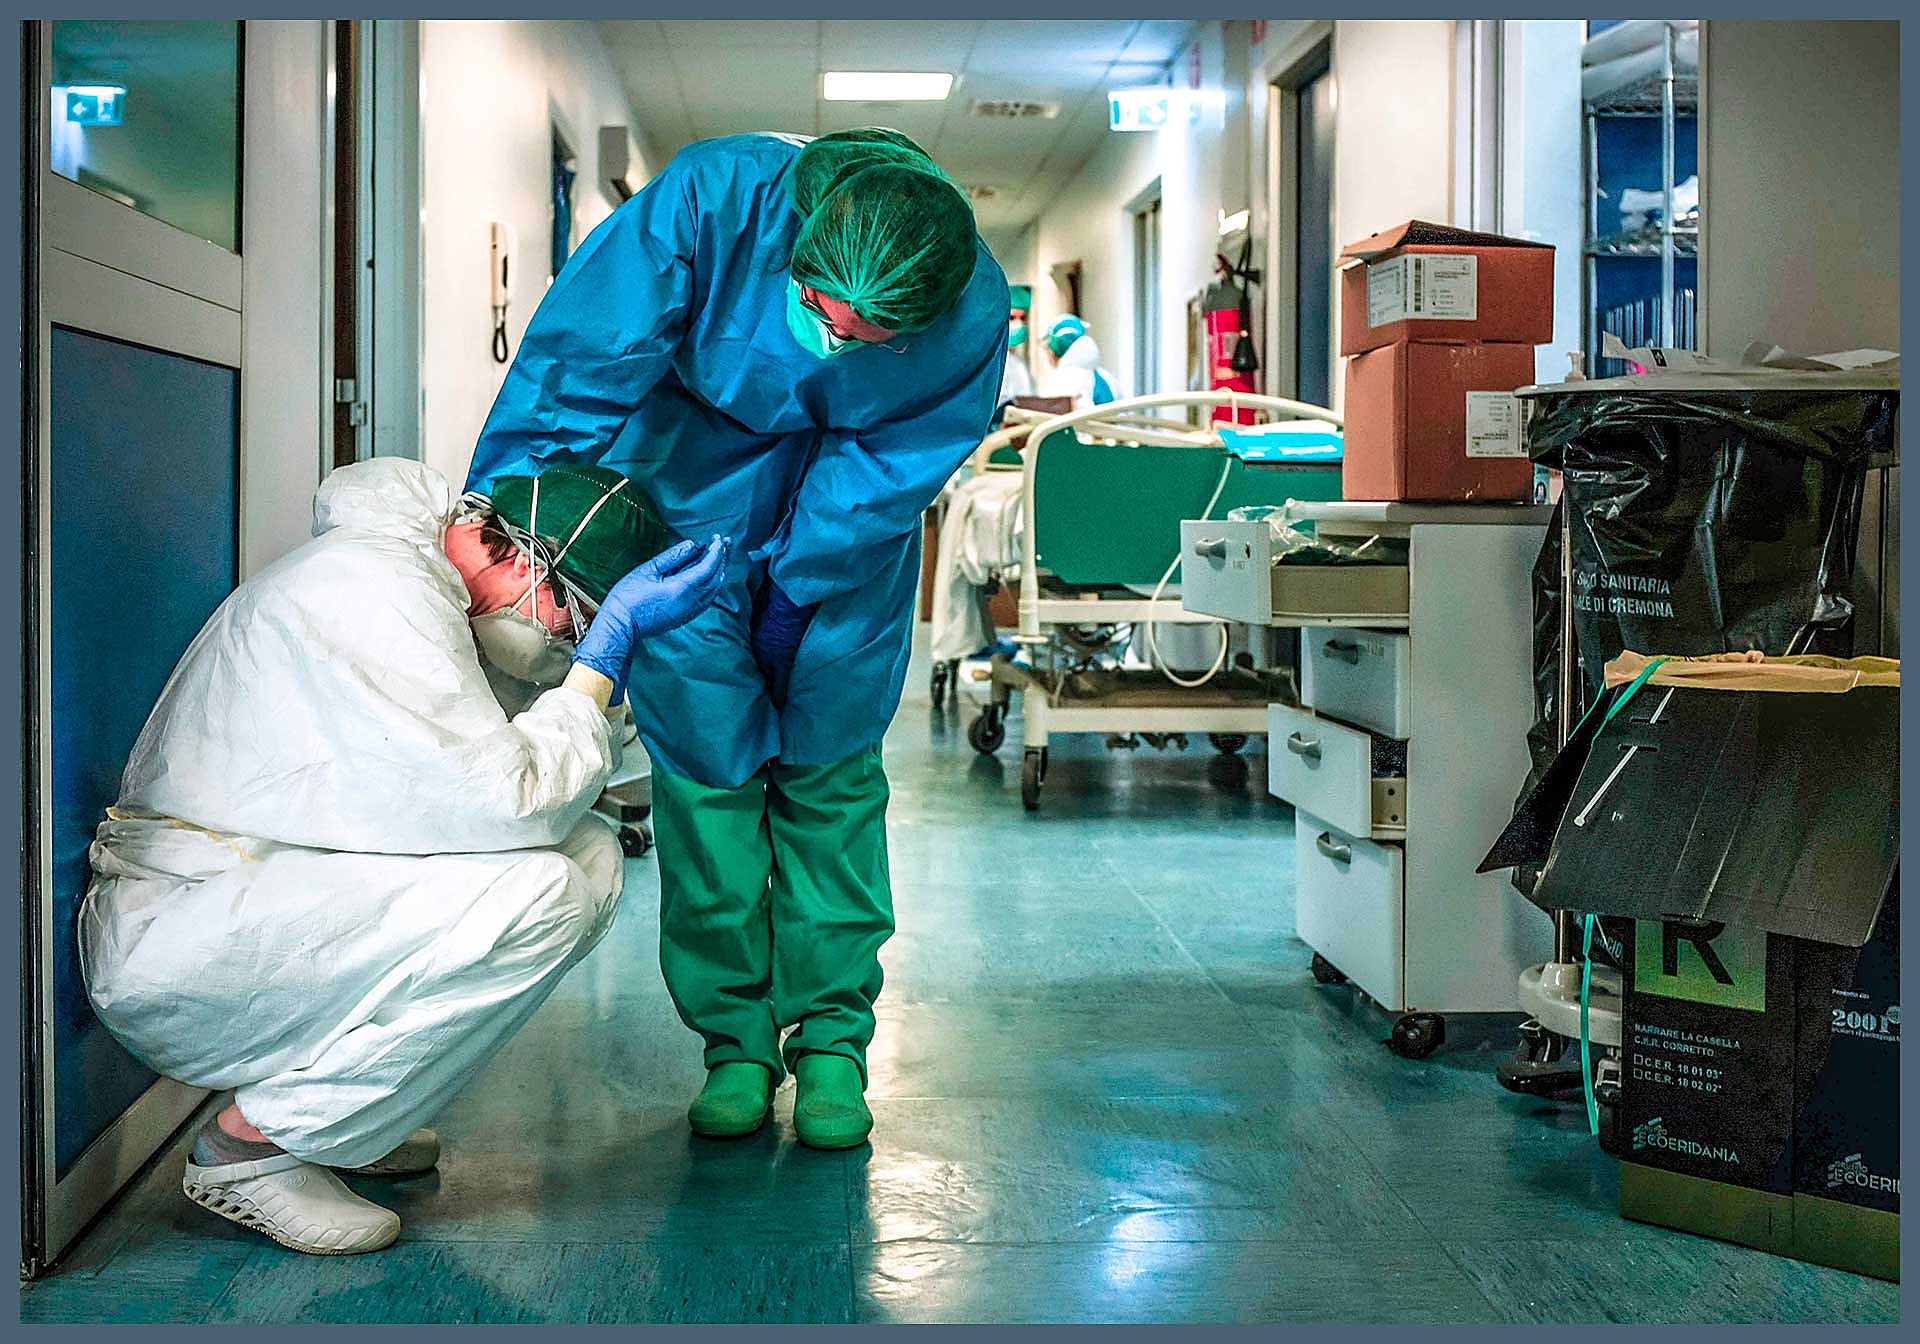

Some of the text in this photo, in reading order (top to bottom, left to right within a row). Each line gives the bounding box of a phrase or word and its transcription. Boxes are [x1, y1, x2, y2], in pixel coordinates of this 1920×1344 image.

[1600, 574, 1671, 595] SANITARIA
[1593, 597, 1605, 613] DI
[1608, 597, 1675, 619] CREMONA
[1660, 917, 1736, 986] R
[1662, 1040, 1715, 1057] CORRETTO
[1681, 1031, 1694, 1041] LA
[1696, 1034, 1742, 1050] CASELLA
[1644, 1057, 1675, 1073] C.E.R.
[1678, 1063, 1690, 1075] 18
[1691, 1066, 1703, 1077] 01
[1644, 1070, 1675, 1086] C.E.R.
[1678, 1077, 1690, 1089] 18
[1691, 1080, 1704, 1091] 02
[1638, 1132, 1740, 1164] ECOERIDANIA
[1834, 1168, 1901, 1195] ECOERI
